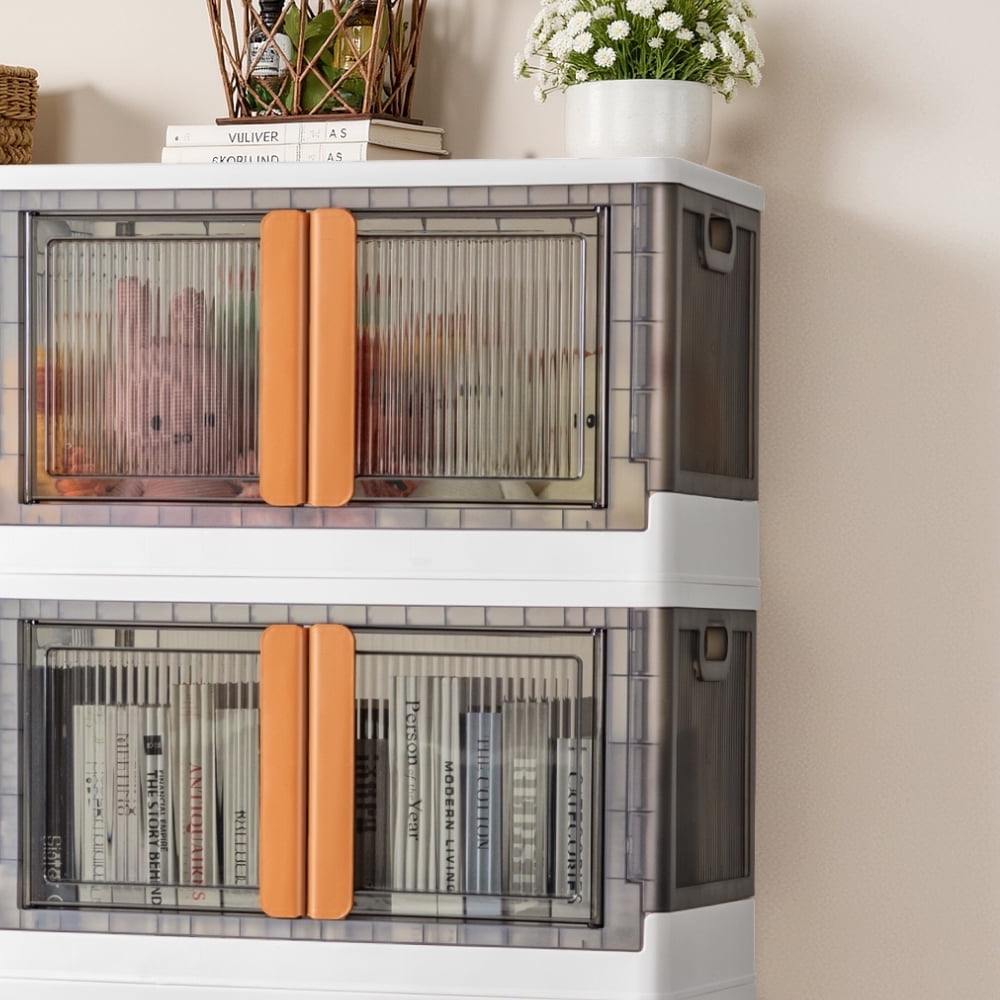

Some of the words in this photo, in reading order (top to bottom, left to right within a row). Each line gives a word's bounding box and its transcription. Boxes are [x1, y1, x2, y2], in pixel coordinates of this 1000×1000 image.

[404, 700, 420, 766] Person
[146, 769, 158, 799] THE
[443, 761, 455, 830] MODERN
[147, 803, 159, 848] STORY
[406, 799, 421, 841] Year
[148, 852, 162, 905] BEHIND
